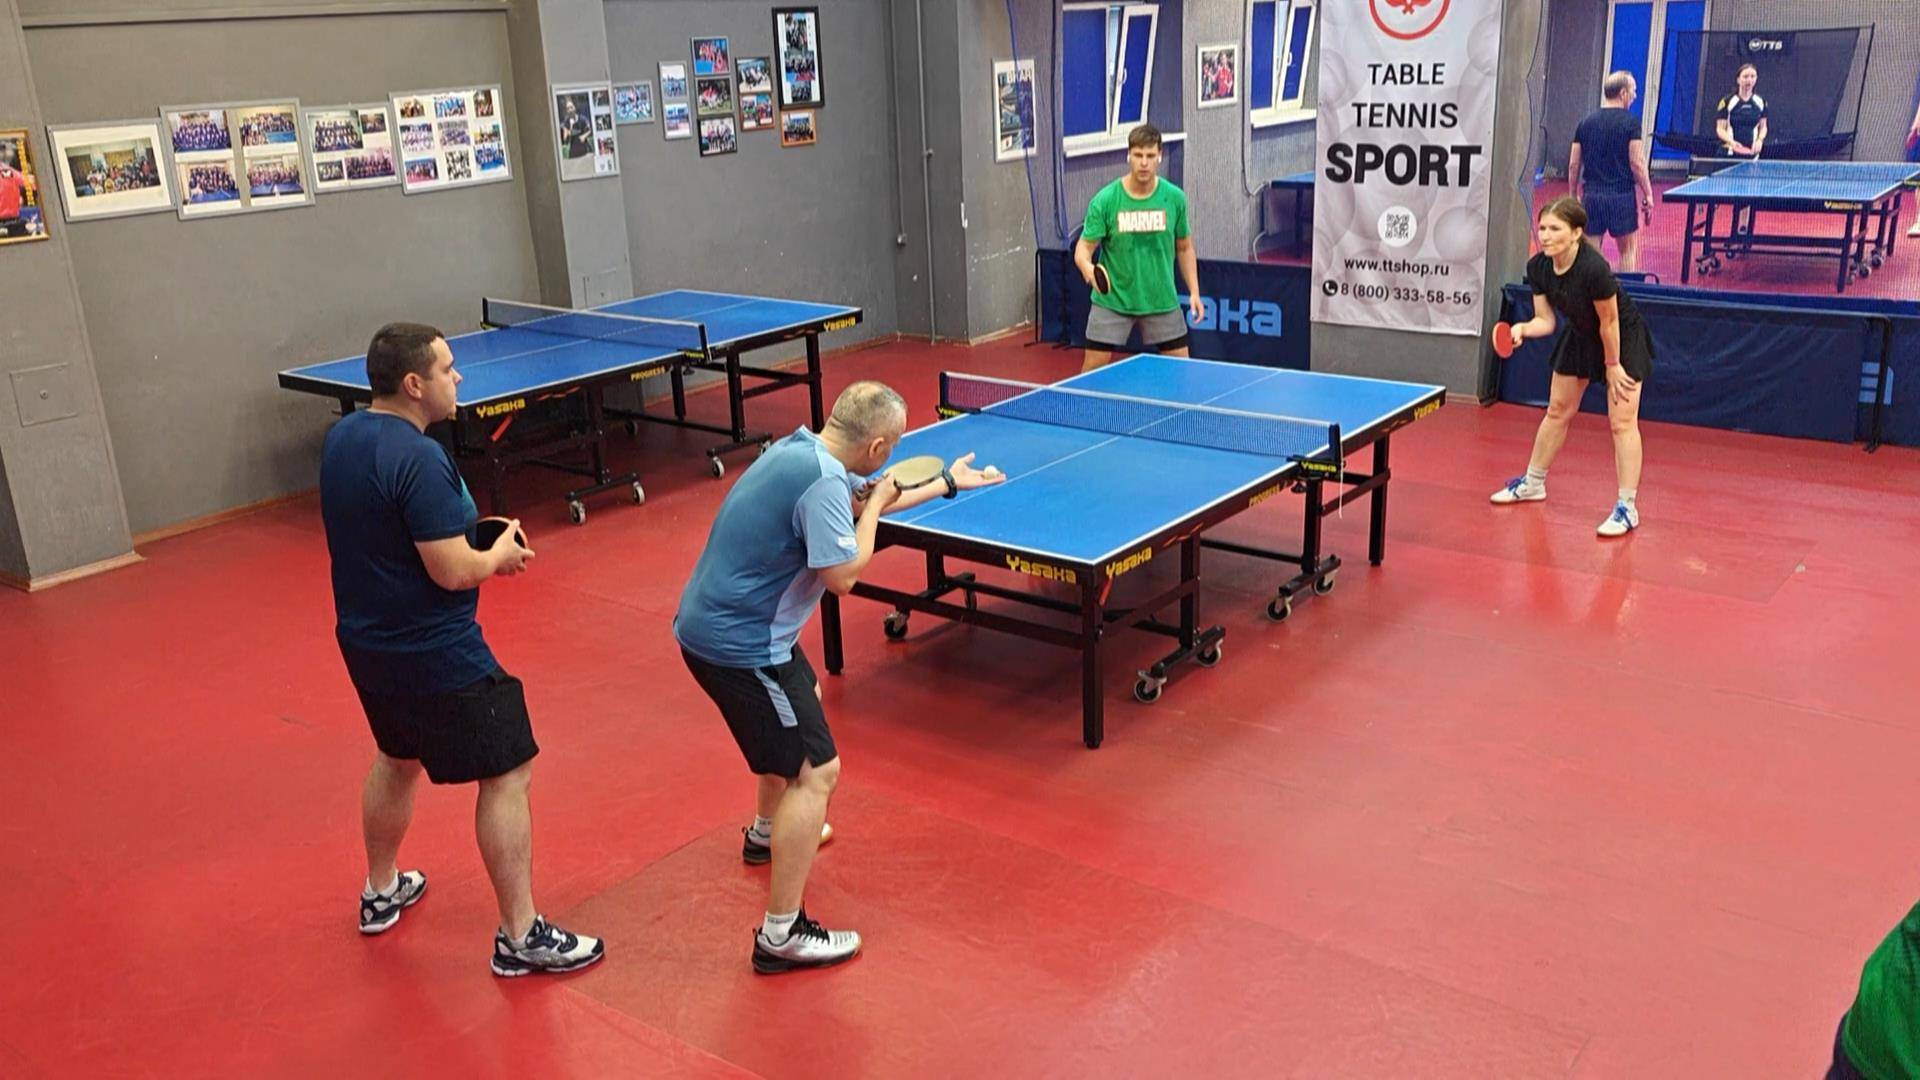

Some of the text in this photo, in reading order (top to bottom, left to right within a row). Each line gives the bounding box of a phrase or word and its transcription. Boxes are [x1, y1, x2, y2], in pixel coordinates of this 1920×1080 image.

[1367, 63, 1446, 86] TABLE
[1351, 102, 1459, 129] TENNIS
[1325, 143, 1483, 188] SPORT
[1117, 210, 1167, 233] MARVEL
[1344, 258, 1449, 277] www.ttshop.ru
[1340, 283, 1472, 305] 8 (800) 333-58-56
[476, 398, 526, 419] Yasaka
[1006, 553, 1077, 585] Yasaka
[1105, 546, 1152, 579] Yasaka
